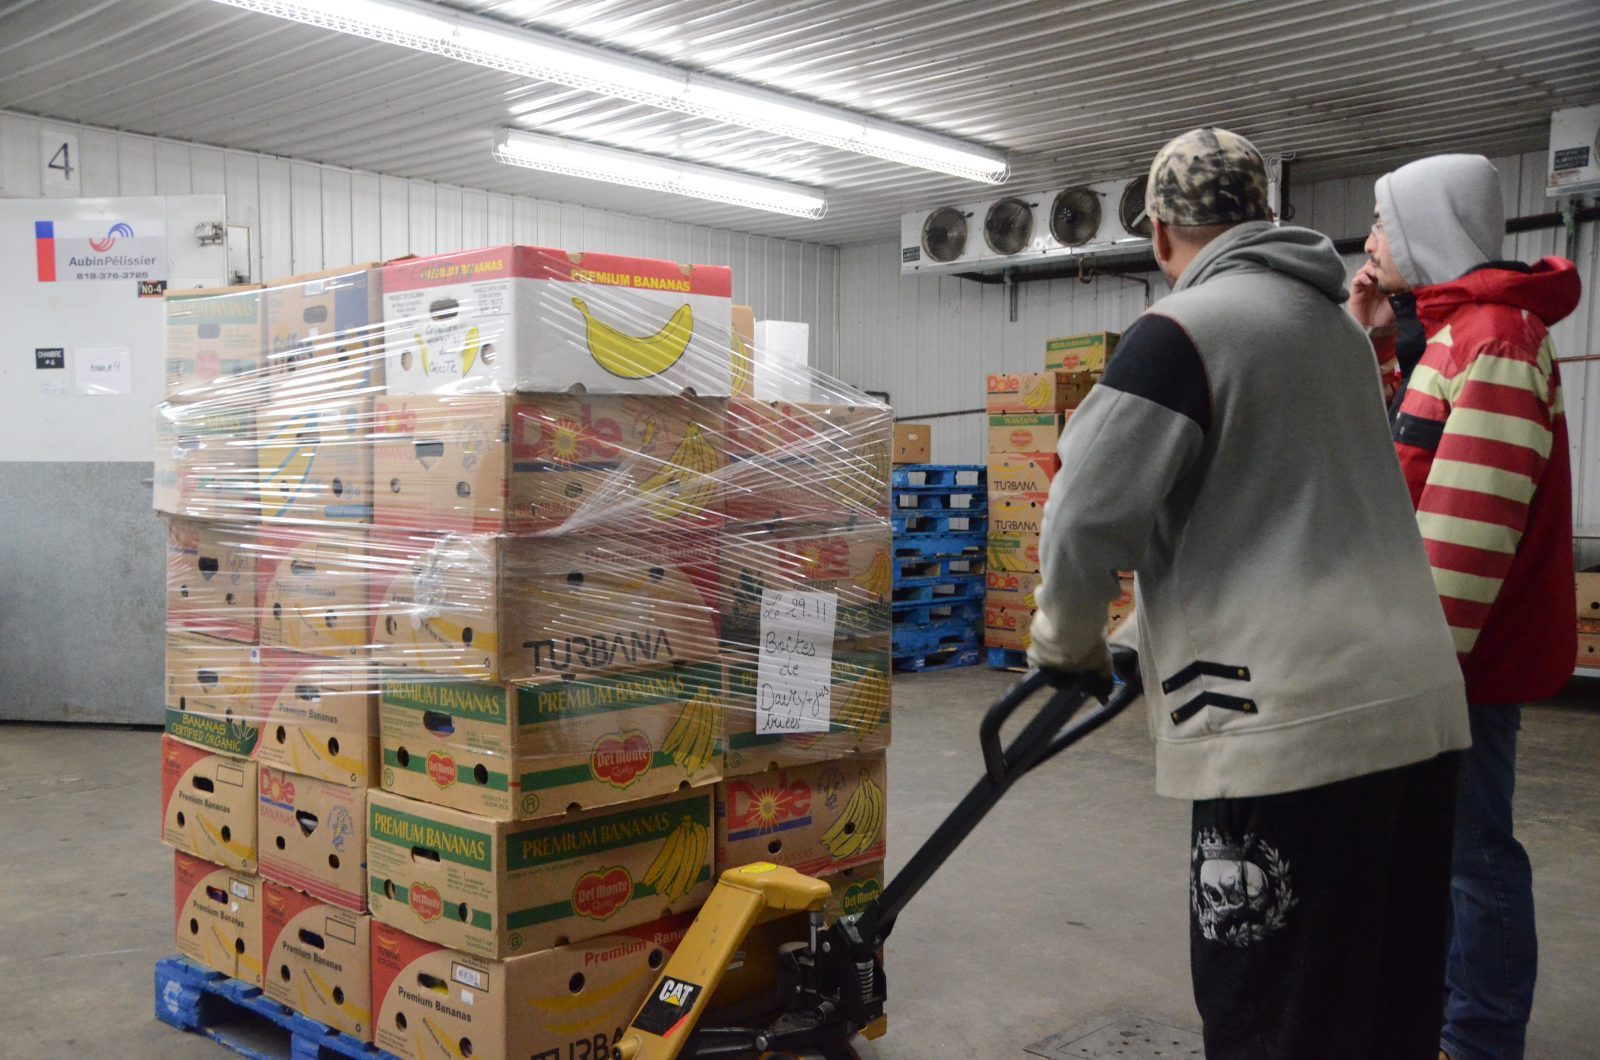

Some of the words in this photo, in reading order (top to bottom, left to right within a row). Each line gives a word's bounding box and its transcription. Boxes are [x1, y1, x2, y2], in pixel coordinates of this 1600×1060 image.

[48, 142, 74, 180] 4
[69, 256, 156, 267] AubinPélissier
[141, 283, 162, 294] NO-4
[571, 269, 630, 286] PREMIUM
[634, 275, 691, 292] BANANAS
[987, 375, 1020, 392] Dole
[512, 404, 624, 460] Dole
[994, 480, 1037, 491] TURBANA
[994, 520, 1038, 531] TURBANA
[987, 572, 1019, 589] Dole
[986, 611, 1017, 629] Dole
[523, 629, 674, 673] TURBANA
[780, 658, 800, 676] de
[387, 680, 438, 705] PREMIUM
[440, 686, 500, 716] BANANAS
[538, 686, 613, 714] PREMIUM
[616, 675, 687, 702] BANANAS
[182, 714, 226, 735] BANANAS
[278, 703, 307, 719] Premium
[309, 707, 338, 725] Bananas
[171, 724, 205, 745] CERTIFIED
[205, 731, 241, 752] ORGANIC
[597, 752, 615, 768] Del
[615, 748, 648, 766] Monte
[260, 767, 296, 803] Dole
[178, 790, 203, 806] Premium
[204, 796, 231, 814] Bananas
[728, 770, 813, 830] Dole
[260, 806, 295, 827] BANANAS
[374, 813, 424, 845] PREMIUM
[426, 827, 485, 862] BANANAS
[522, 831, 597, 860] PREMIUM
[600, 812, 671, 844] BANANAS
[578, 889, 595, 904] Del
[596, 879, 629, 898] Monte
[845, 893, 857, 908] Del
[193, 899, 219, 917] Premium
[220, 910, 245, 929] Bananas
[282, 940, 312, 961] Premium
[313, 952, 343, 972] Bananas
[584, 939, 647, 967] Premium
[398, 986, 433, 1009] Premium
[435, 1000, 472, 1022] Bananas
[660, 979, 694, 1007] CAT
